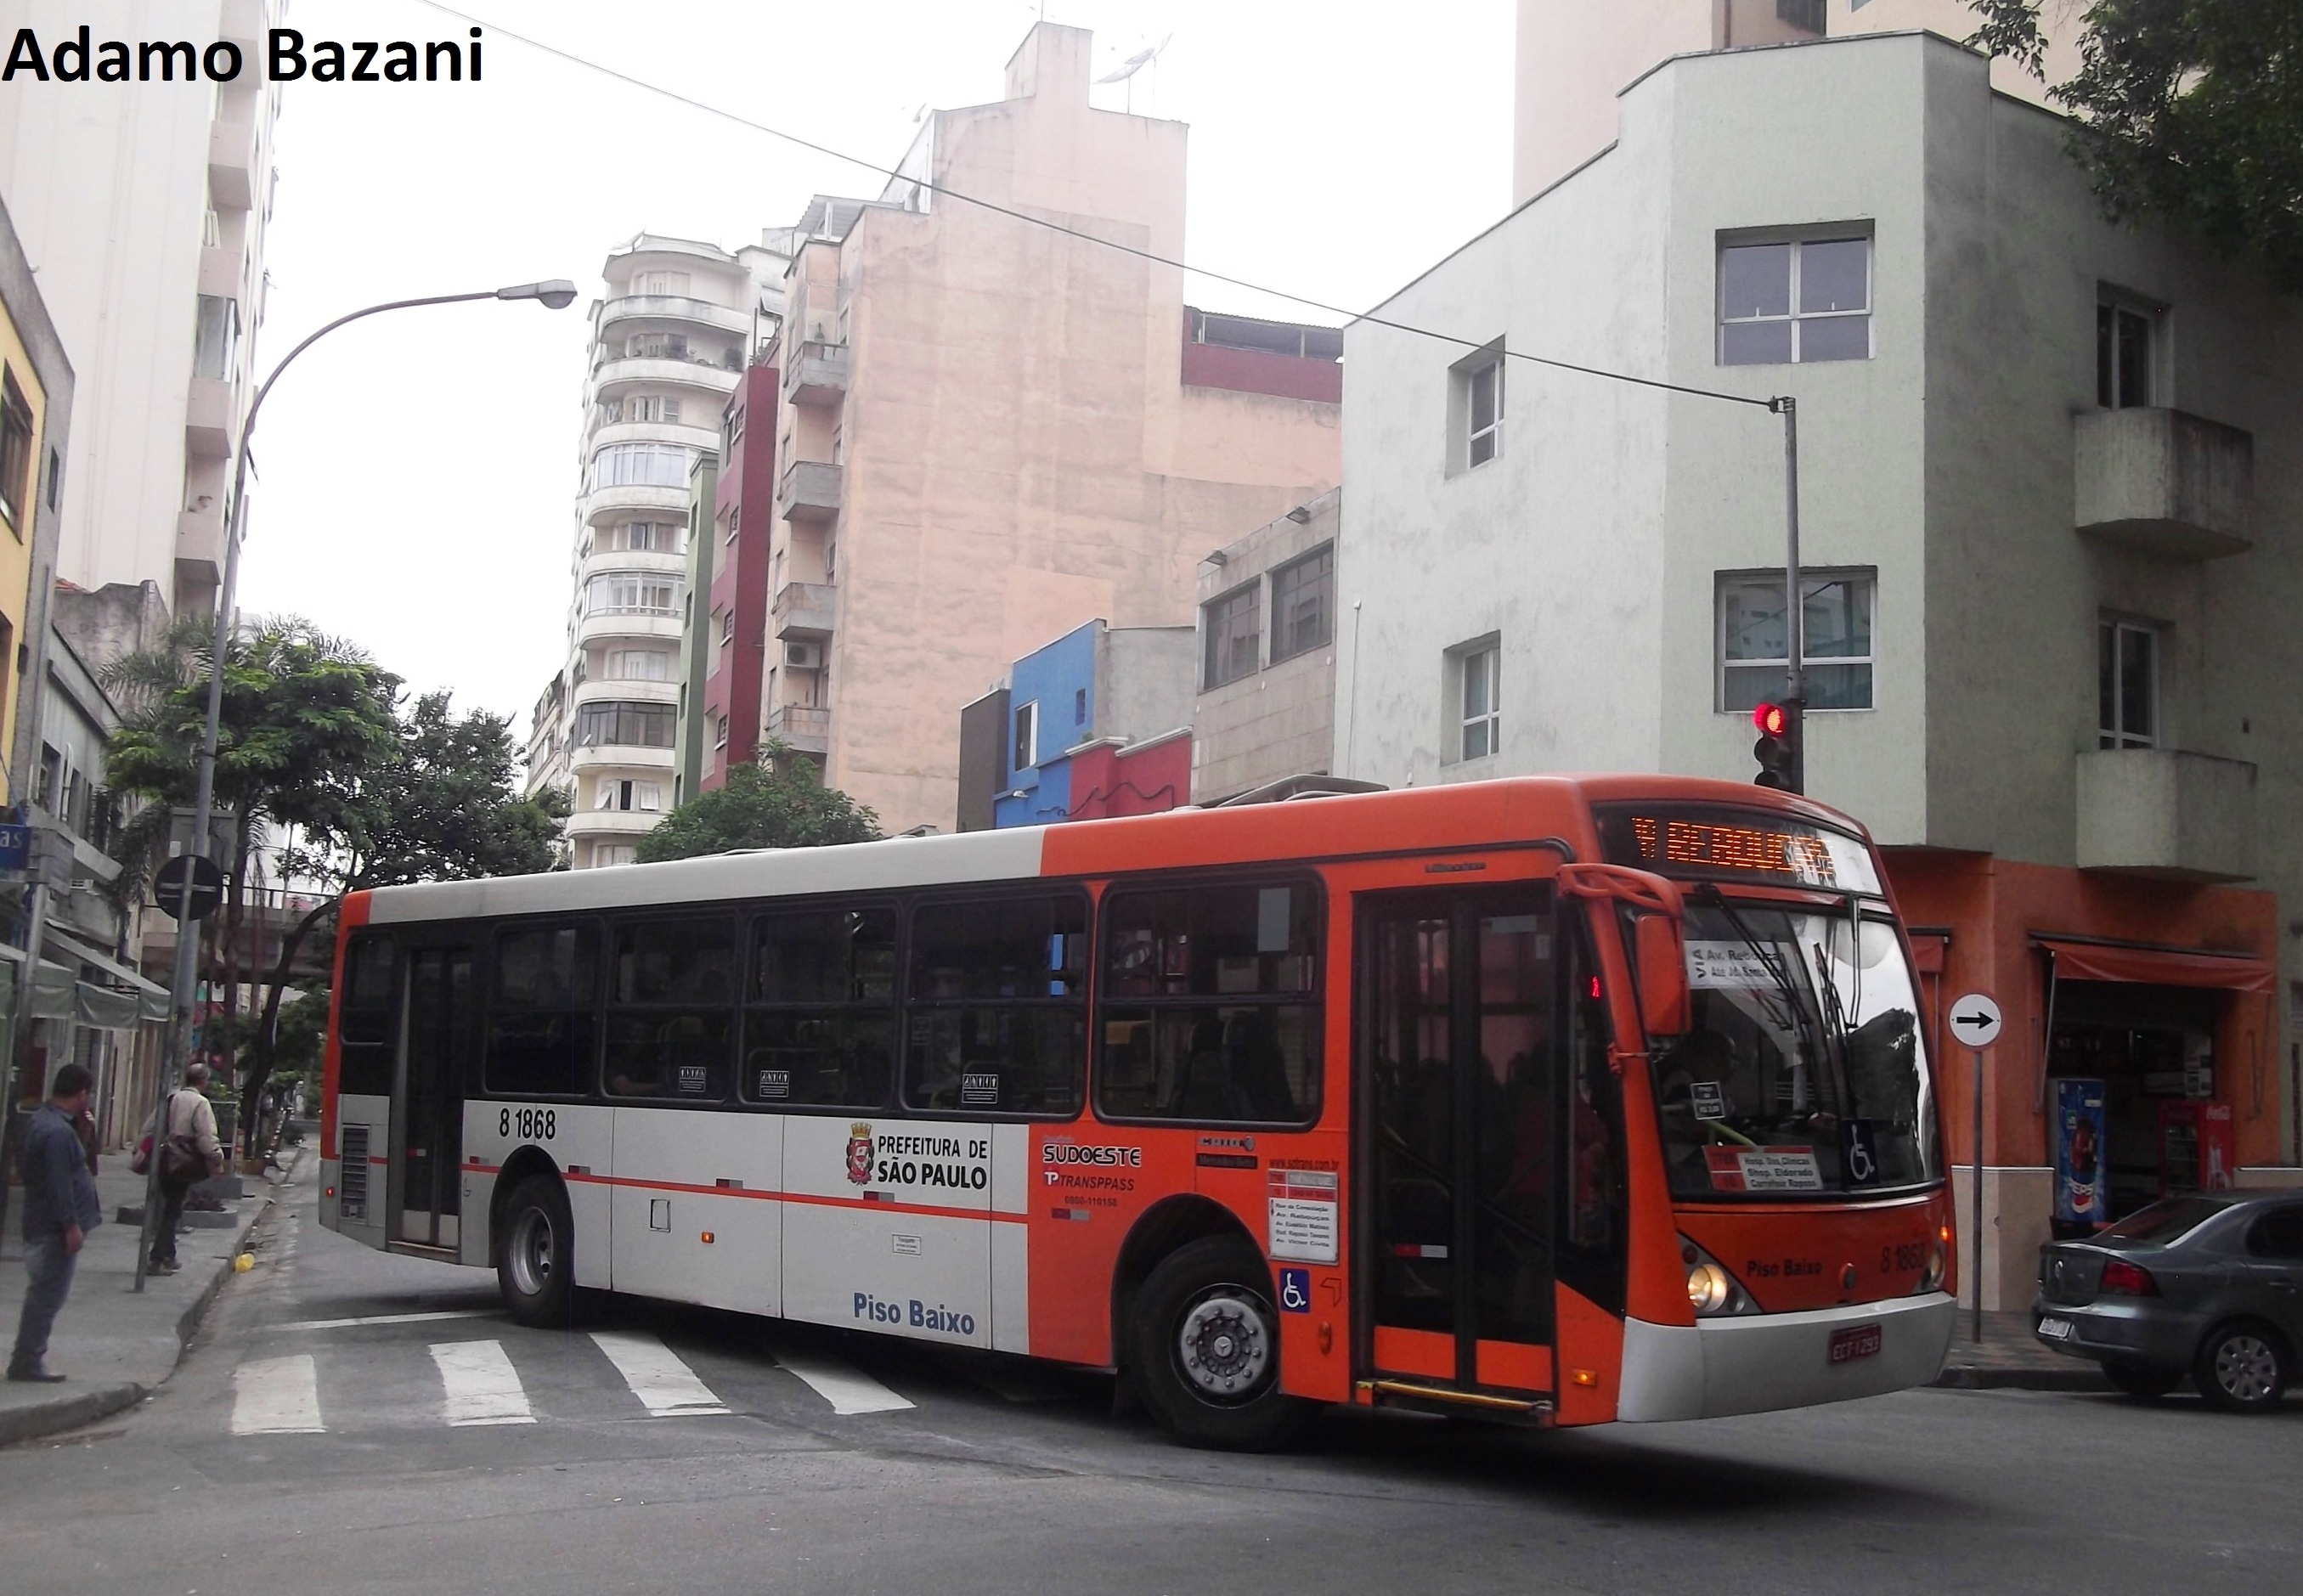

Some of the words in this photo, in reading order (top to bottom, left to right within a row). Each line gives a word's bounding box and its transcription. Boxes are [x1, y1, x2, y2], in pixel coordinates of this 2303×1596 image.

[499, 1108, 510, 1137] 8
[515, 1108, 556, 1140] 1868
[878, 1135, 961, 1158] PREFEITURA
[968, 1139, 988, 1159] DE
[1043, 1143, 1142, 1168] SUDOESTE
[878, 1156, 917, 1184] SÃO
[921, 1163, 987, 1190] PAULO
[1059, 1174, 1135, 1192] TRANSPPASS
[1747, 1260, 1779, 1278] Piso
[1784, 1258, 1823, 1277] Baixo
[853, 1291, 901, 1324] Piso
[908, 1298, 976, 1336] Baixo
